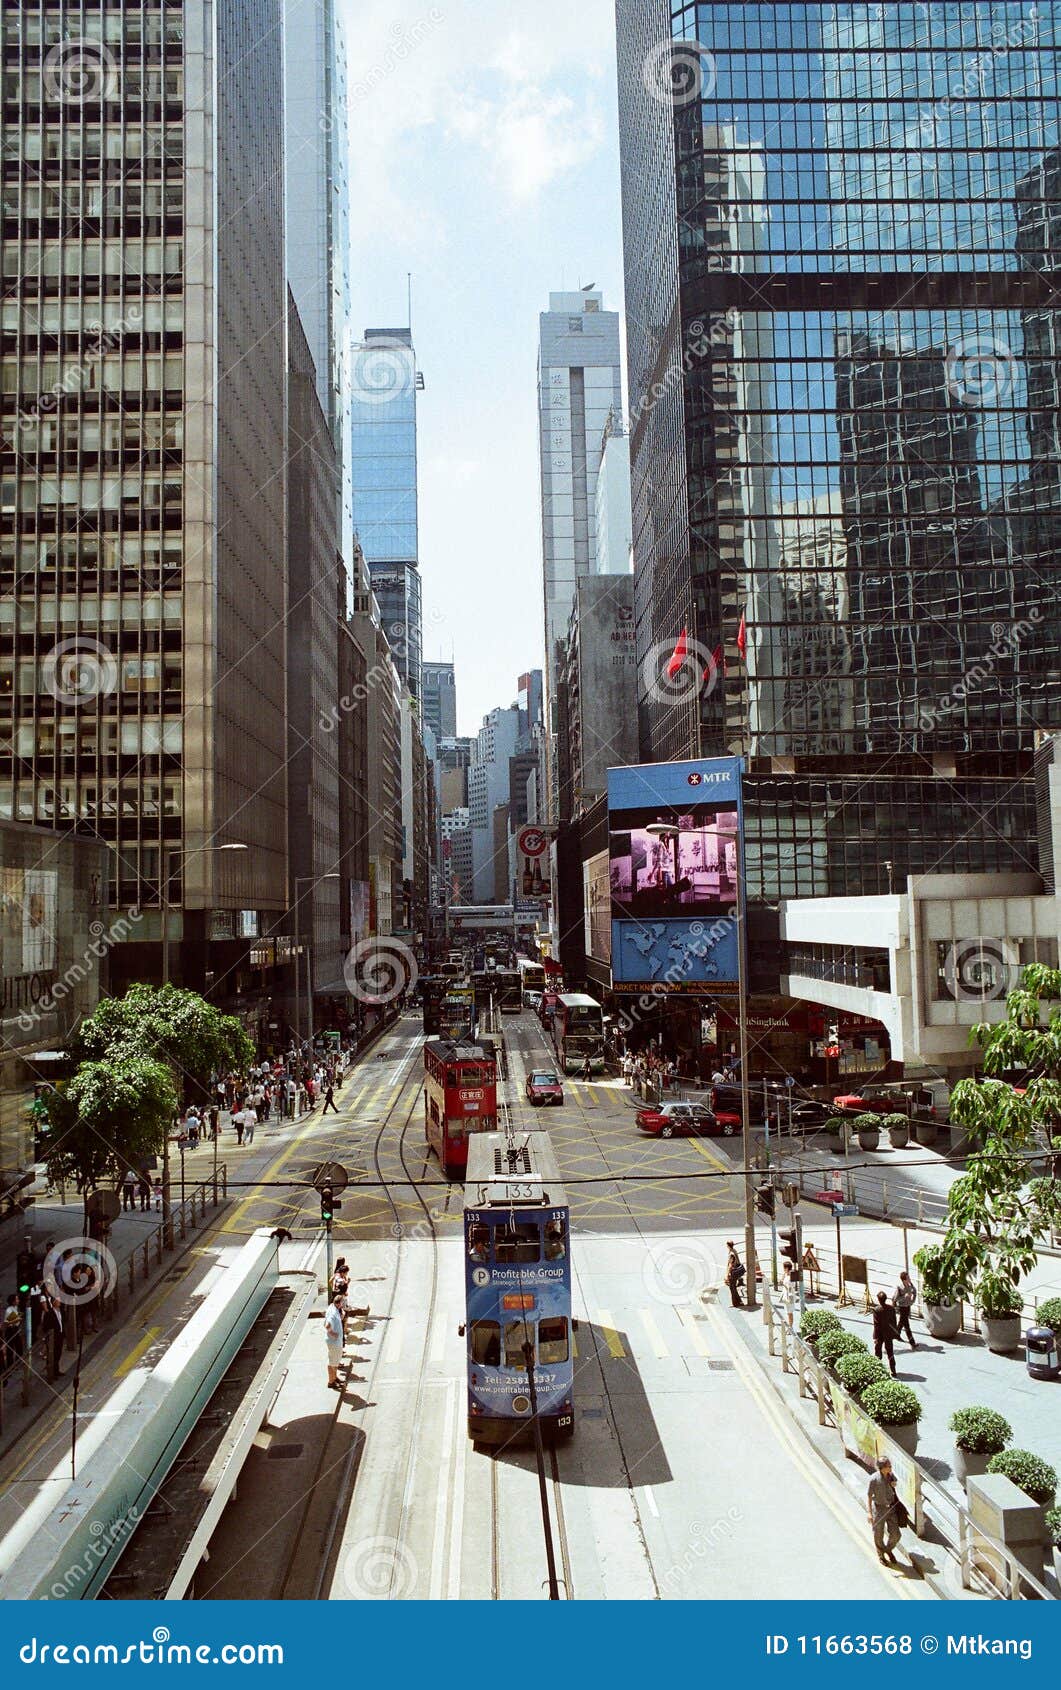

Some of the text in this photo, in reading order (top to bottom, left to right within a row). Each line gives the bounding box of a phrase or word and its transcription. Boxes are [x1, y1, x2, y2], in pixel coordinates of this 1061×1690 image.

[703, 772, 730, 783] MTR
[505, 1184, 532, 1198] 133
[467, 1213, 480, 1221] 133
[552, 1211, 566, 1219] 133
[492, 1268, 564, 1279] Profitable Group
[484, 1376, 502, 1384] Tel:
[475, 1383, 567, 1394] www.profitableroup.com
[557, 1416, 571, 1427] 133
